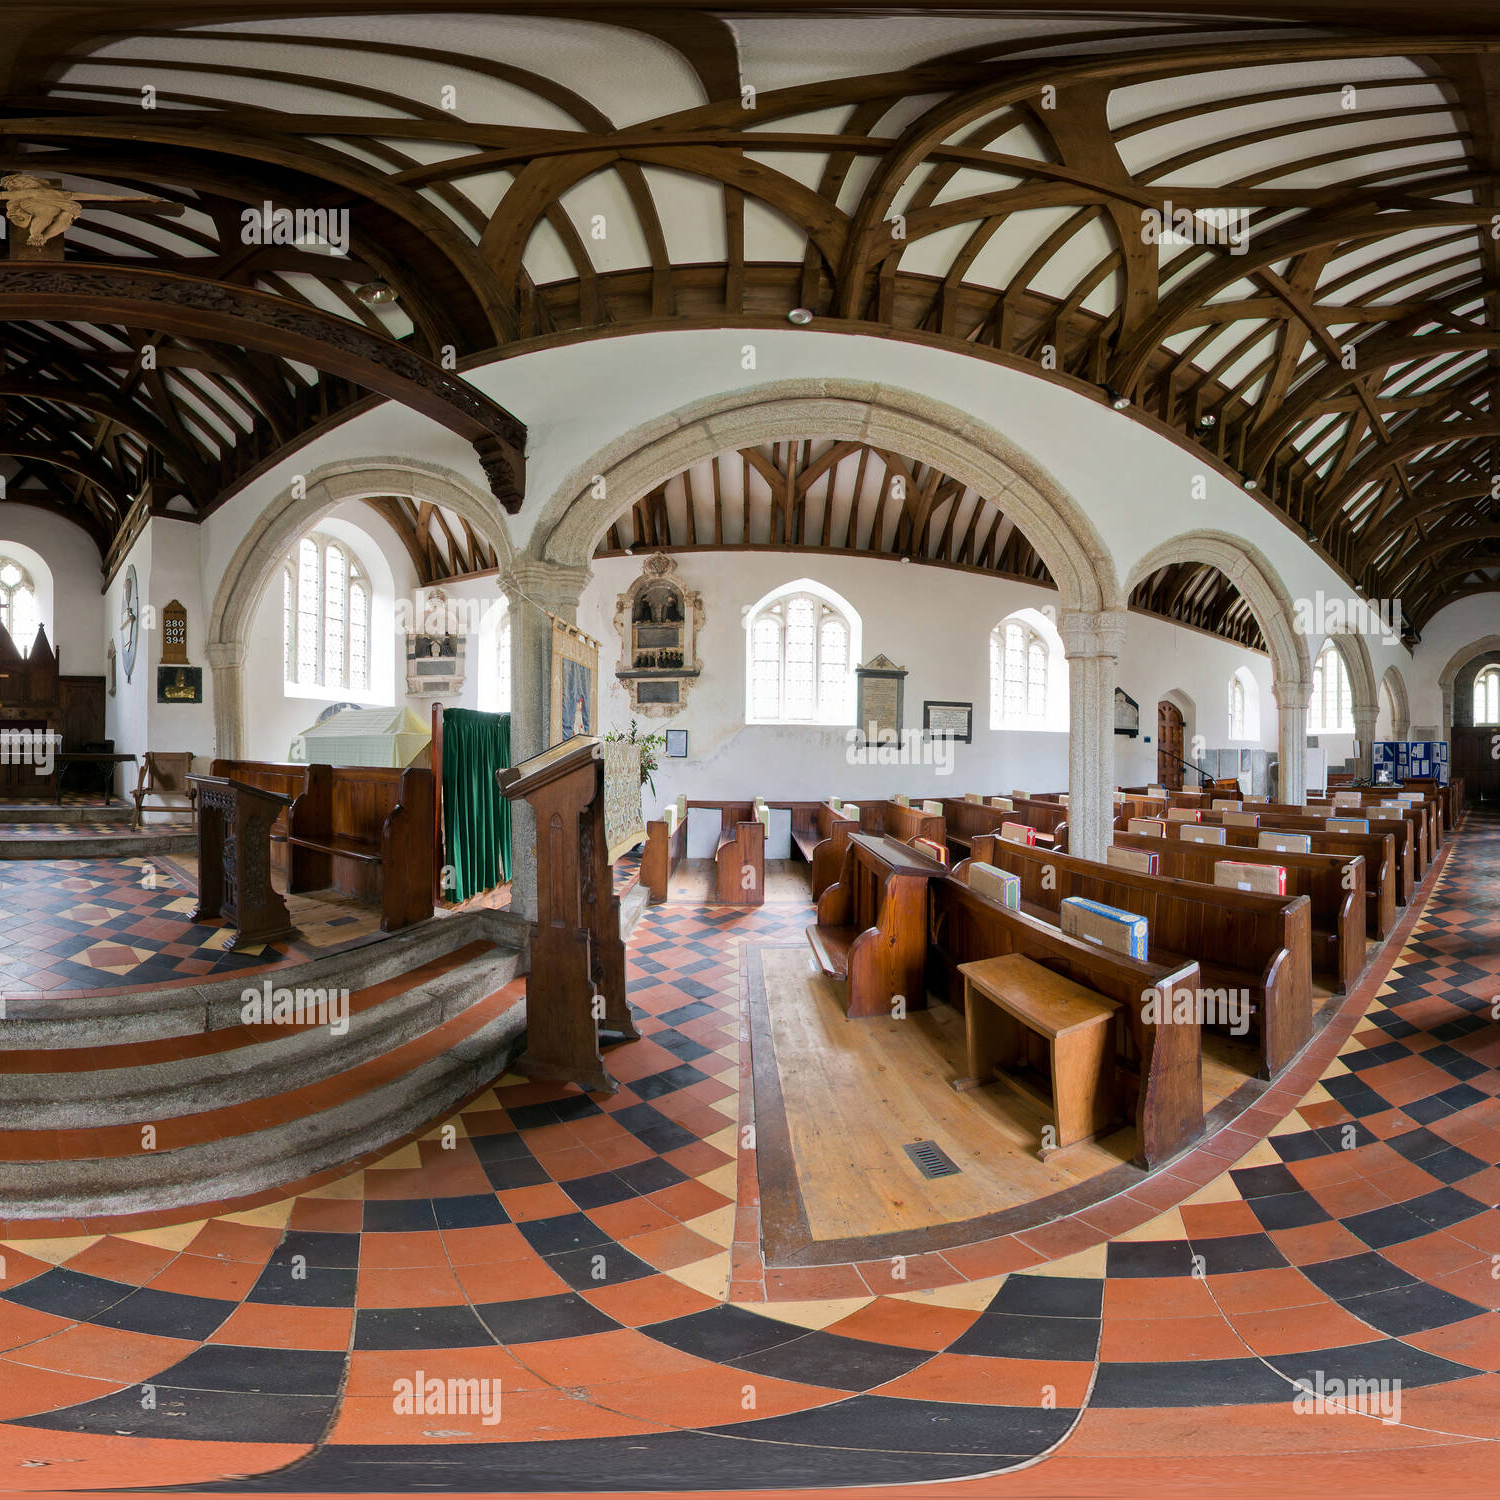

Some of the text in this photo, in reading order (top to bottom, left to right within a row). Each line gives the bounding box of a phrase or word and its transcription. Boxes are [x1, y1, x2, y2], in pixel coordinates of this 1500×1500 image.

[165, 619, 184, 627] 280
[166, 628, 185, 636] 207
[166, 636, 185, 644] 394
